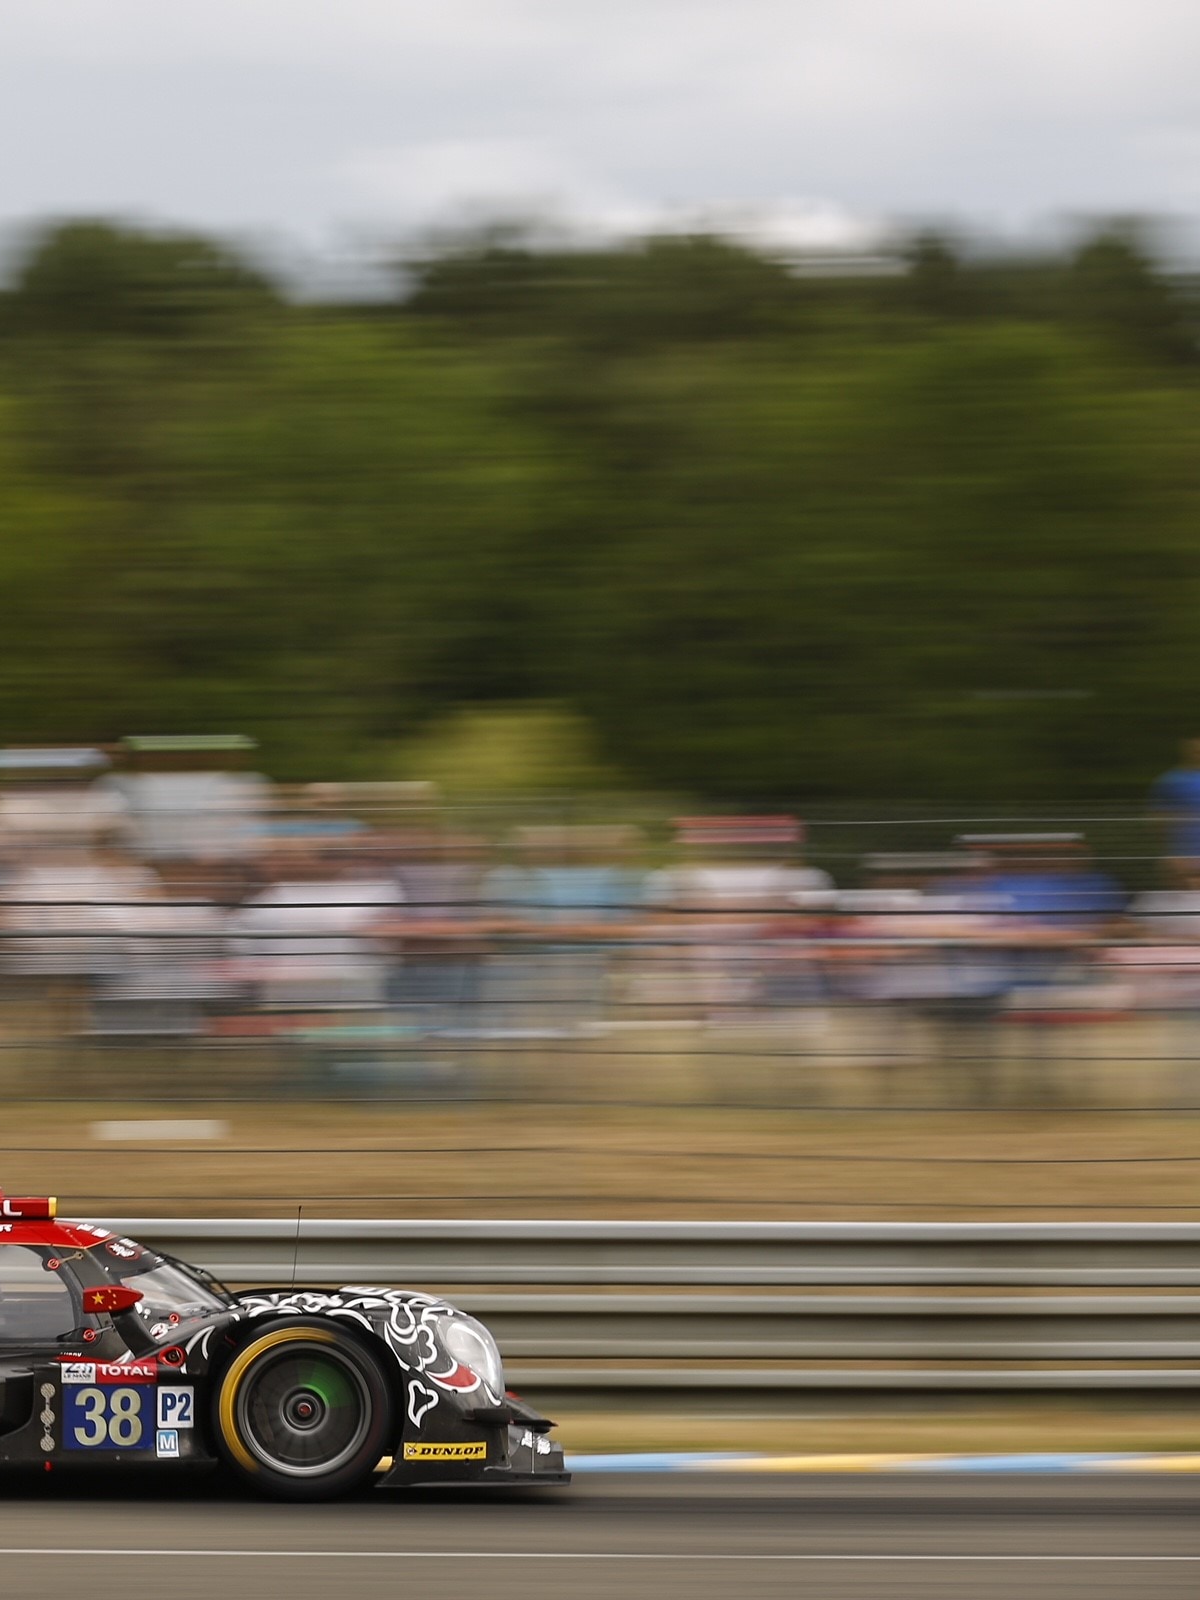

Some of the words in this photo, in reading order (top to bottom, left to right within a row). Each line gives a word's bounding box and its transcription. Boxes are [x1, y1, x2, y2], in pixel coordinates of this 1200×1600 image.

[97, 1364, 155, 1377] TOTAL
[161, 1393, 191, 1422] P2
[74, 1387, 142, 1446] 38
[160, 1434, 175, 1449] M
[419, 1446, 484, 1455] DUNLOP
